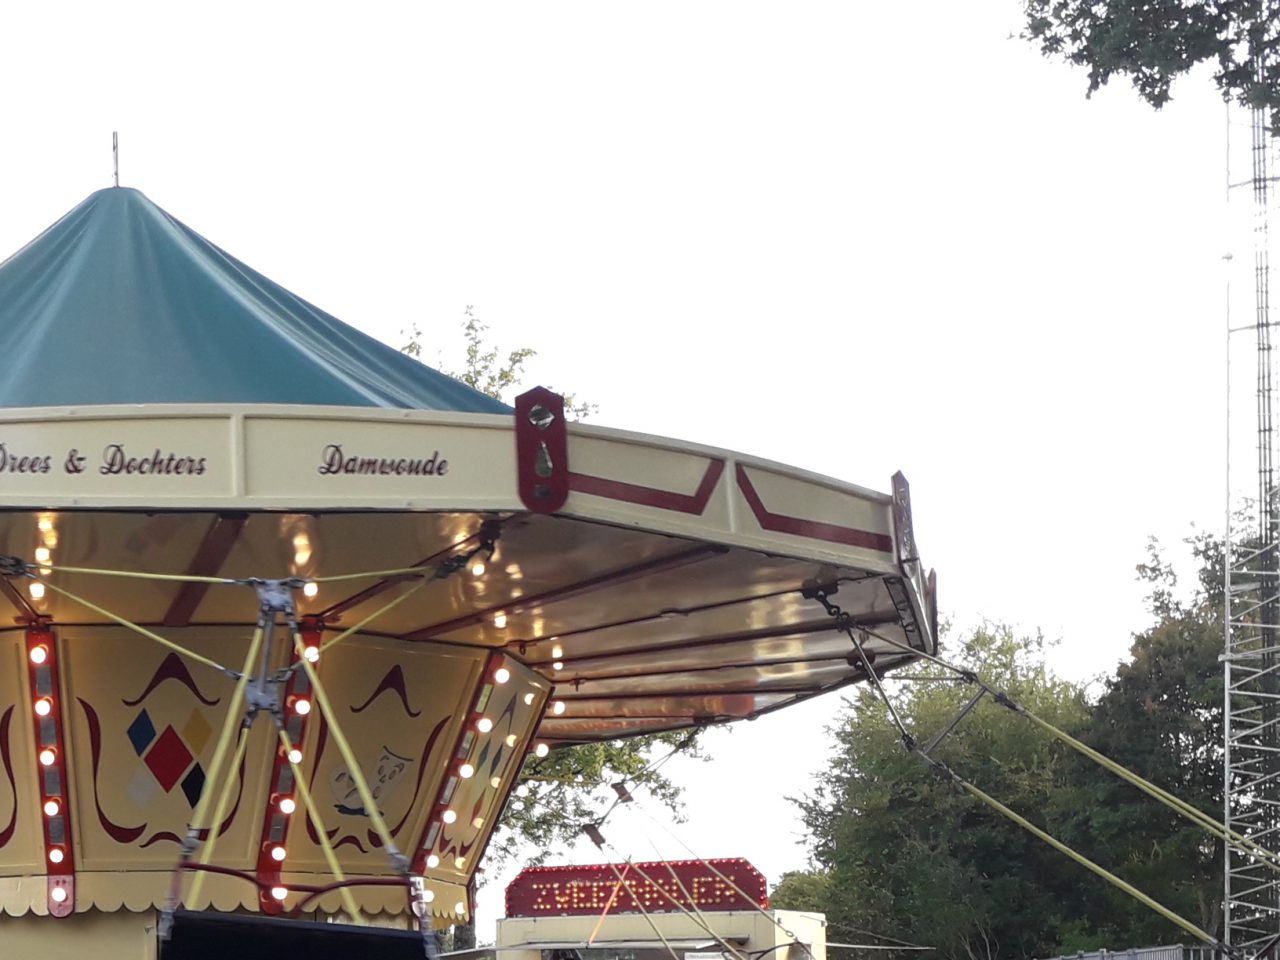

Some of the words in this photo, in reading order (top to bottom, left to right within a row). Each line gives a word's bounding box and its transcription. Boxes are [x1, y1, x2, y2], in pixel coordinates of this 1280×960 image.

[64, 449, 87, 474] &
[99, 444, 208, 475] Dochters
[317, 444, 450, 476] Damwoude
